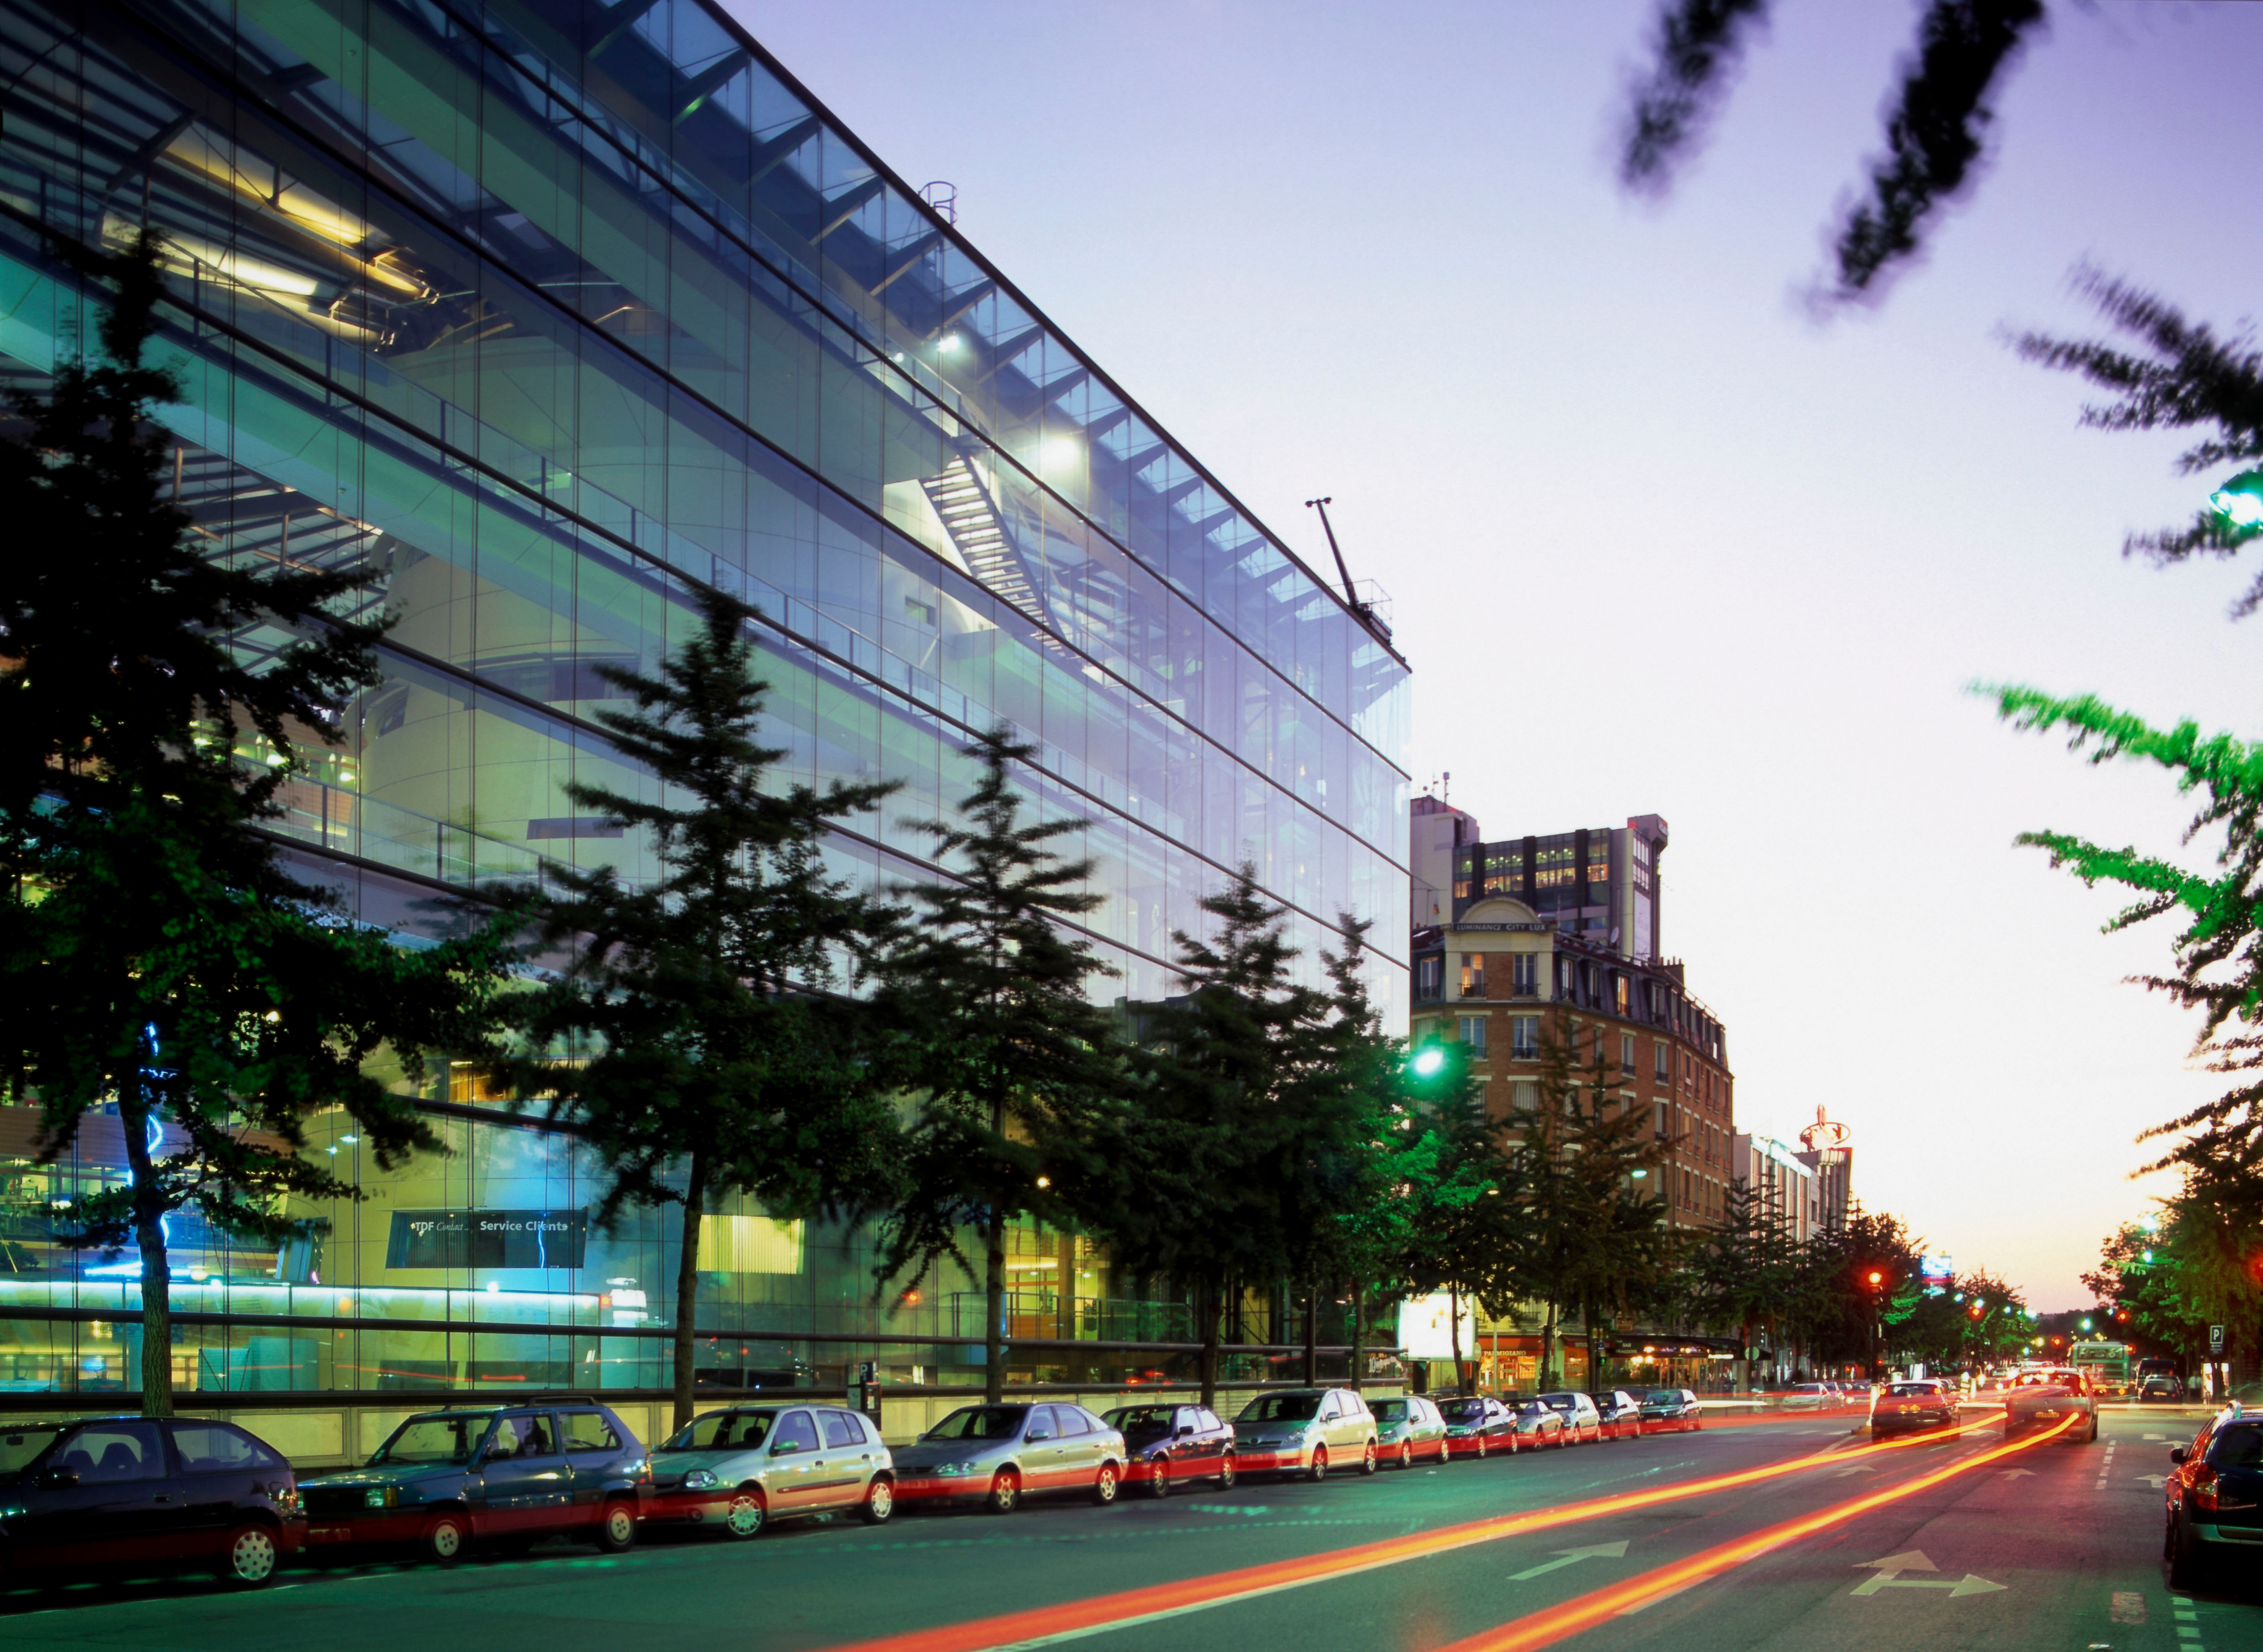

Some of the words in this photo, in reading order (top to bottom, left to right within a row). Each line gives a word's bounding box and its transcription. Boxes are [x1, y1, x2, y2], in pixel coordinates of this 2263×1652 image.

[415, 1221, 434, 1231] TDF
[480, 1221, 522, 1231] Service
[525, 1221, 568, 1231] Clients
[2214, 1329, 2220, 1340] P
[860, 1364, 868, 1376] P
